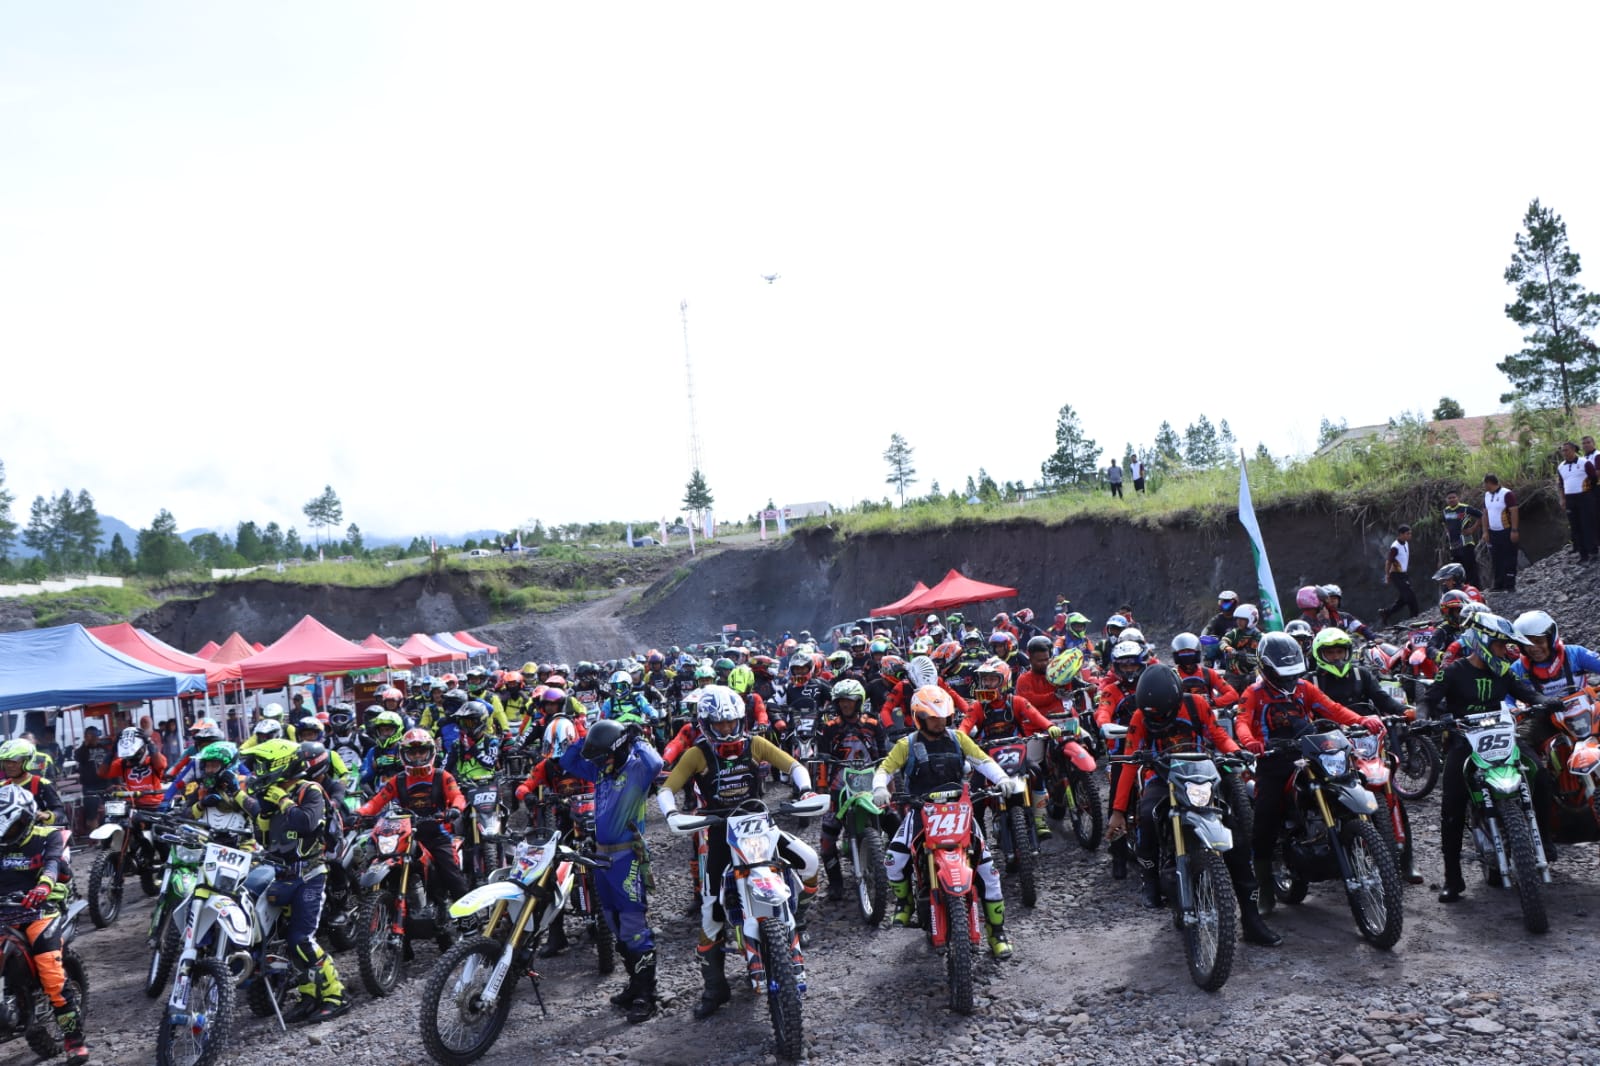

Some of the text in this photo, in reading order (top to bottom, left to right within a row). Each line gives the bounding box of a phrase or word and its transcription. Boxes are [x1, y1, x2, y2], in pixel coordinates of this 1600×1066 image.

[1477, 733, 1511, 753] 85
[997, 751, 1020, 766] 23
[927, 813, 968, 837] 741
[216, 849, 246, 867] 887
